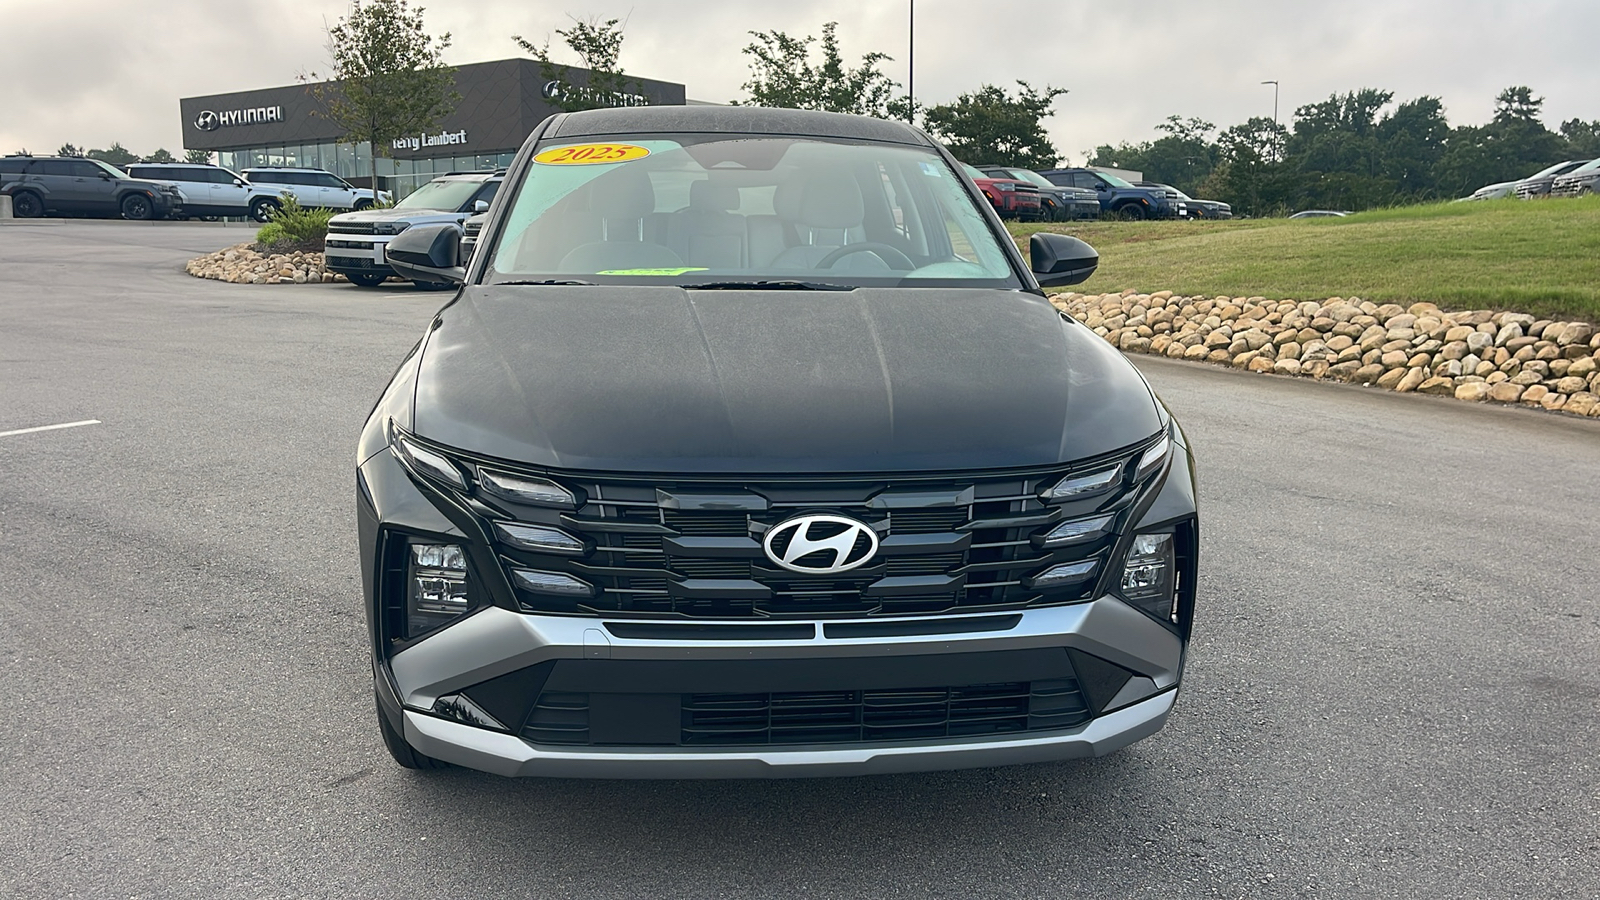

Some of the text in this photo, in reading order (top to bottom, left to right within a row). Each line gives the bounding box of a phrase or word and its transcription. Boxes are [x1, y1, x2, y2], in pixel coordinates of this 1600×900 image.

[220, 106, 282, 126] HYUNDAI
[421, 129, 467, 147] Lambert
[550, 147, 633, 162] 2025
